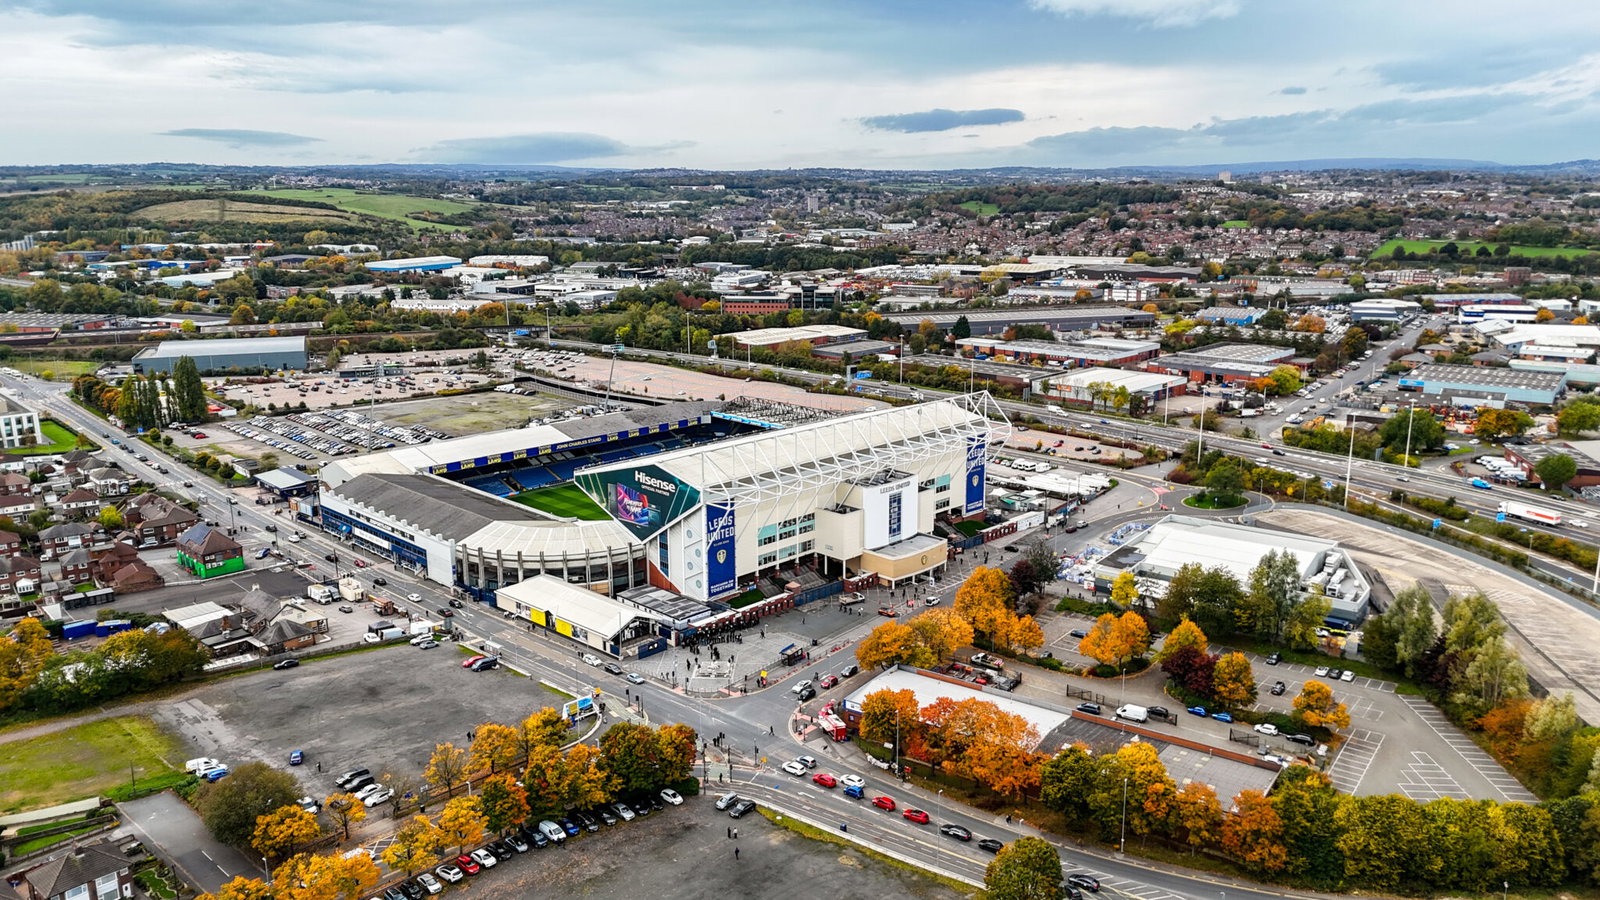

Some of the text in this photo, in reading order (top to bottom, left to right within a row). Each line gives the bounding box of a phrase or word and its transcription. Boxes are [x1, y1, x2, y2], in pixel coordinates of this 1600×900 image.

[635, 470, 676, 493] Hisense
[880, 480, 910, 494] LEEDS UNITED
[708, 516, 733, 530] LEEDS
[708, 526, 735, 542] UNITED
